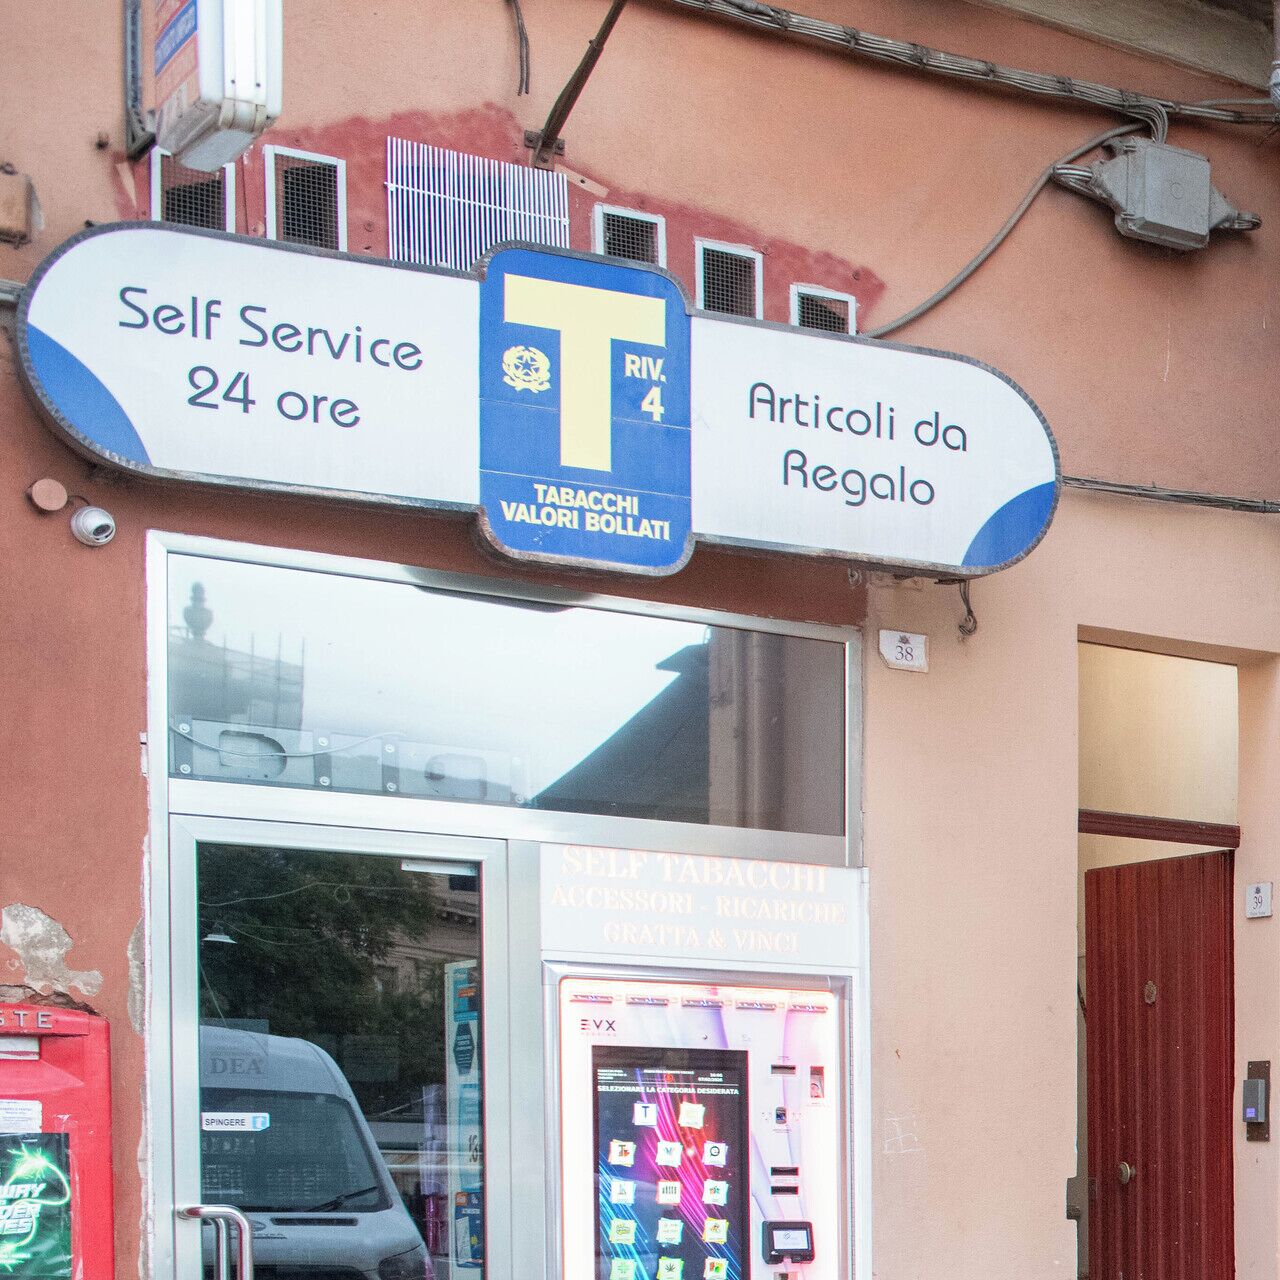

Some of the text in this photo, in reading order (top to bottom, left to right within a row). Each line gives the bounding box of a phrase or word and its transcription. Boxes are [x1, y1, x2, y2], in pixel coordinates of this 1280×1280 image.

[118, 286, 424, 372] Self Service
[503, 274, 667, 474] T
[624, 352, 667, 384] RIV.
[186, 365, 361, 429] 24 ore
[640, 387, 665, 422] 4
[747, 382, 968, 452] Articoli da
[532, 481, 640, 515] TABACCHI
[783, 449, 935, 507] Regalo
[501, 498, 670, 543] VALORI BOLLATI
[895, 645, 914, 662] 38
[561, 844, 829, 895] SELF TABACCHI
[550, 883, 694, 914] ACCESSORI
[715, 895, 849, 924] RICARICHE
[602, 920, 702, 948] GRATTA
[733, 929, 801, 953] VINCI
[580, 1019, 616, 1032] EVX
[204, 1118, 246, 1127] SPINGERE
